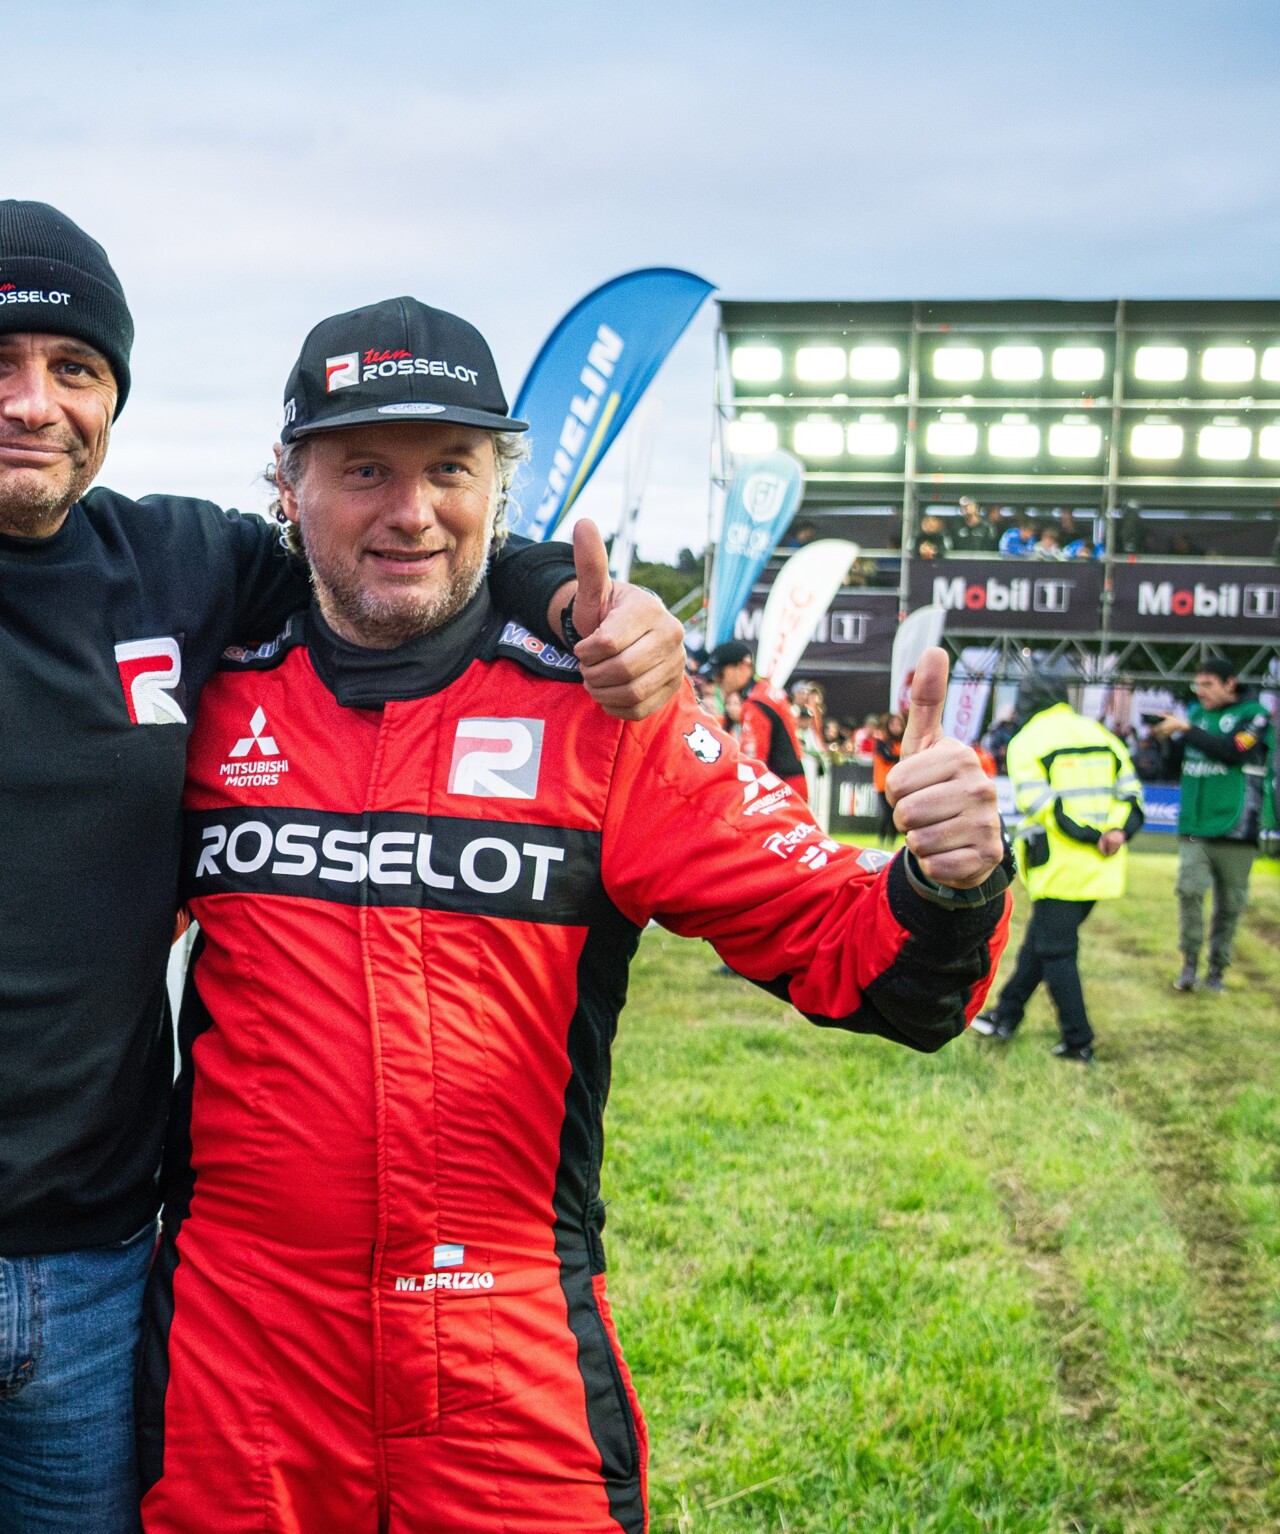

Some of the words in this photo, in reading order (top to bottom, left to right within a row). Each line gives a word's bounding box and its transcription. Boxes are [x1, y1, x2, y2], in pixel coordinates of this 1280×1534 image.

[363, 348, 412, 363] team
[362, 359, 479, 387] ROSSELOT
[932, 577, 1031, 611] Mobil
[1138, 581, 1240, 617] Mobil
[220, 759, 289, 776] MITSUBISHI
[224, 774, 279, 787] MOTORS
[195, 820, 565, 900] ROSSELOT
[395, 1271, 495, 1292] M.BRIZIO
